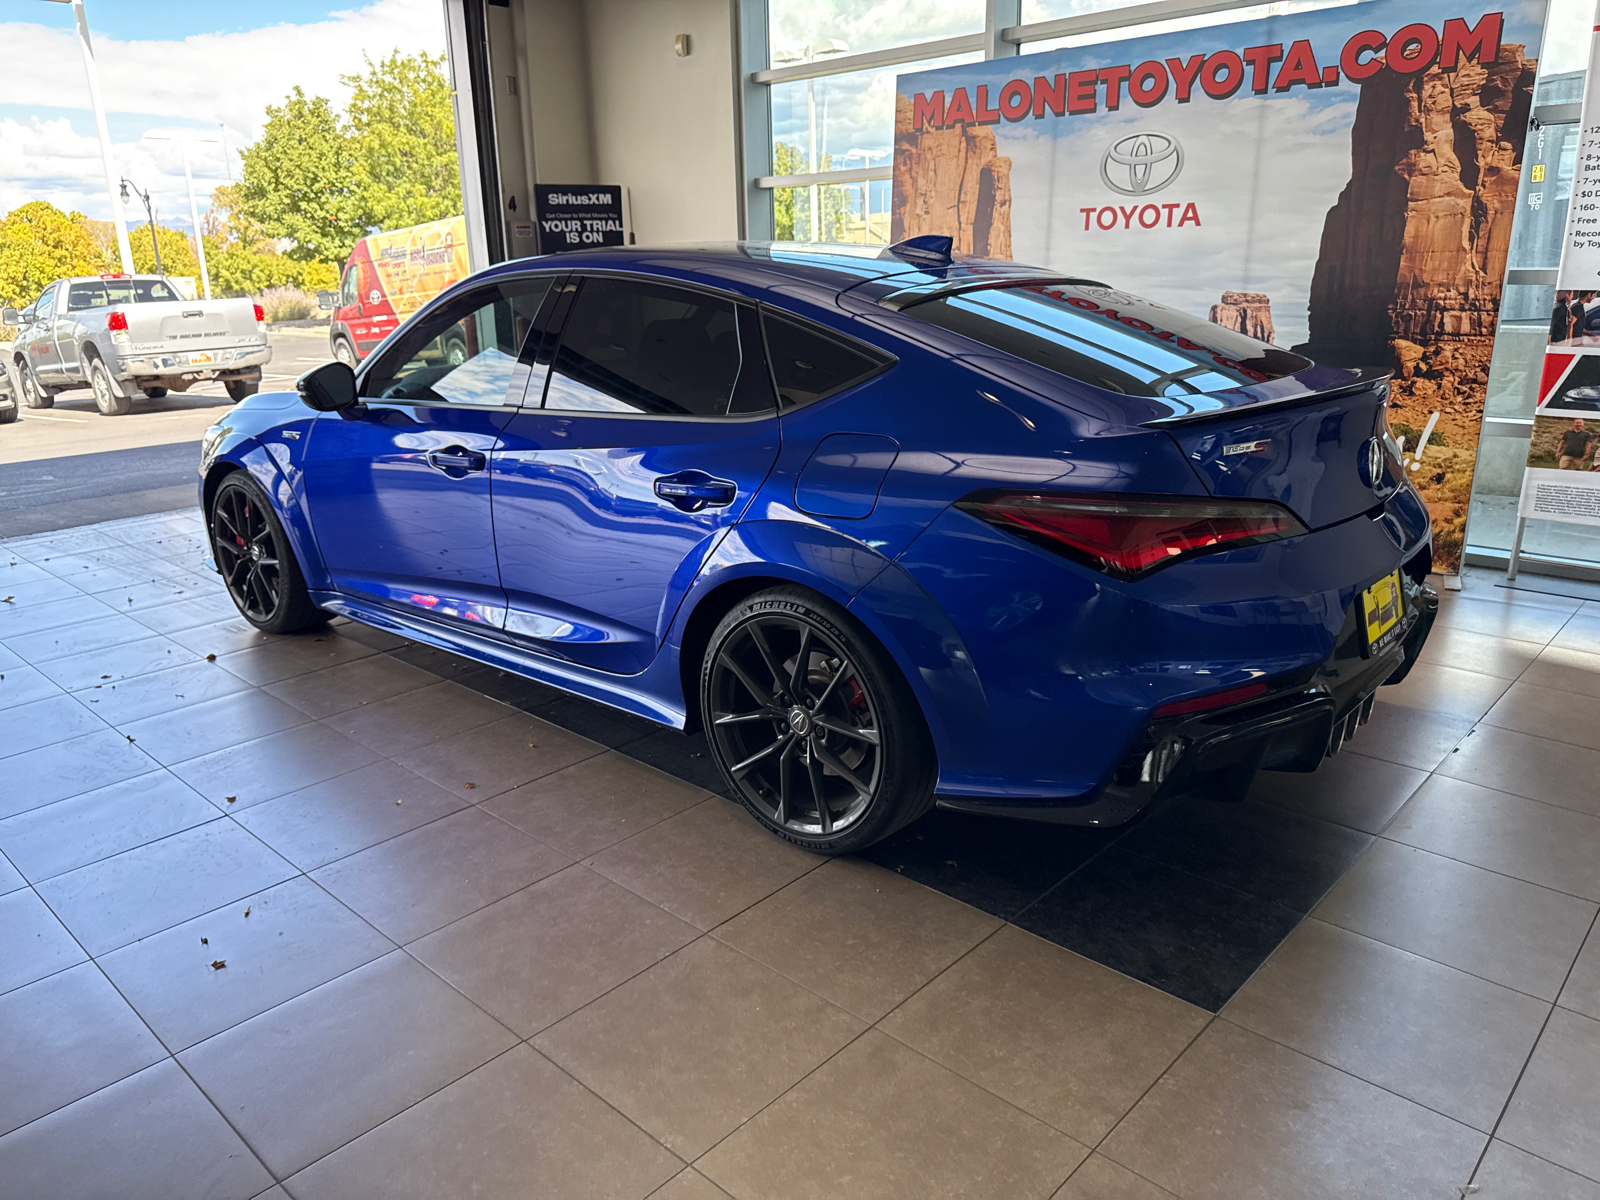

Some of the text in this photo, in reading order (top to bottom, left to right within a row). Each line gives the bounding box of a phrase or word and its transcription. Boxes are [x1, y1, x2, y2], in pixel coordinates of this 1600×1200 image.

[913, 11, 1503, 130] MALONETOYOTA.COM
[547, 193, 613, 205] SiriusXM
[1080, 202, 1202, 231] TOYOTA
[542, 220, 623, 232] YOUR TRIAL
[566, 232, 603, 243] IS ON
[1573, 240, 1586, 249] by
[752, 601, 806, 614] MICHELIN
